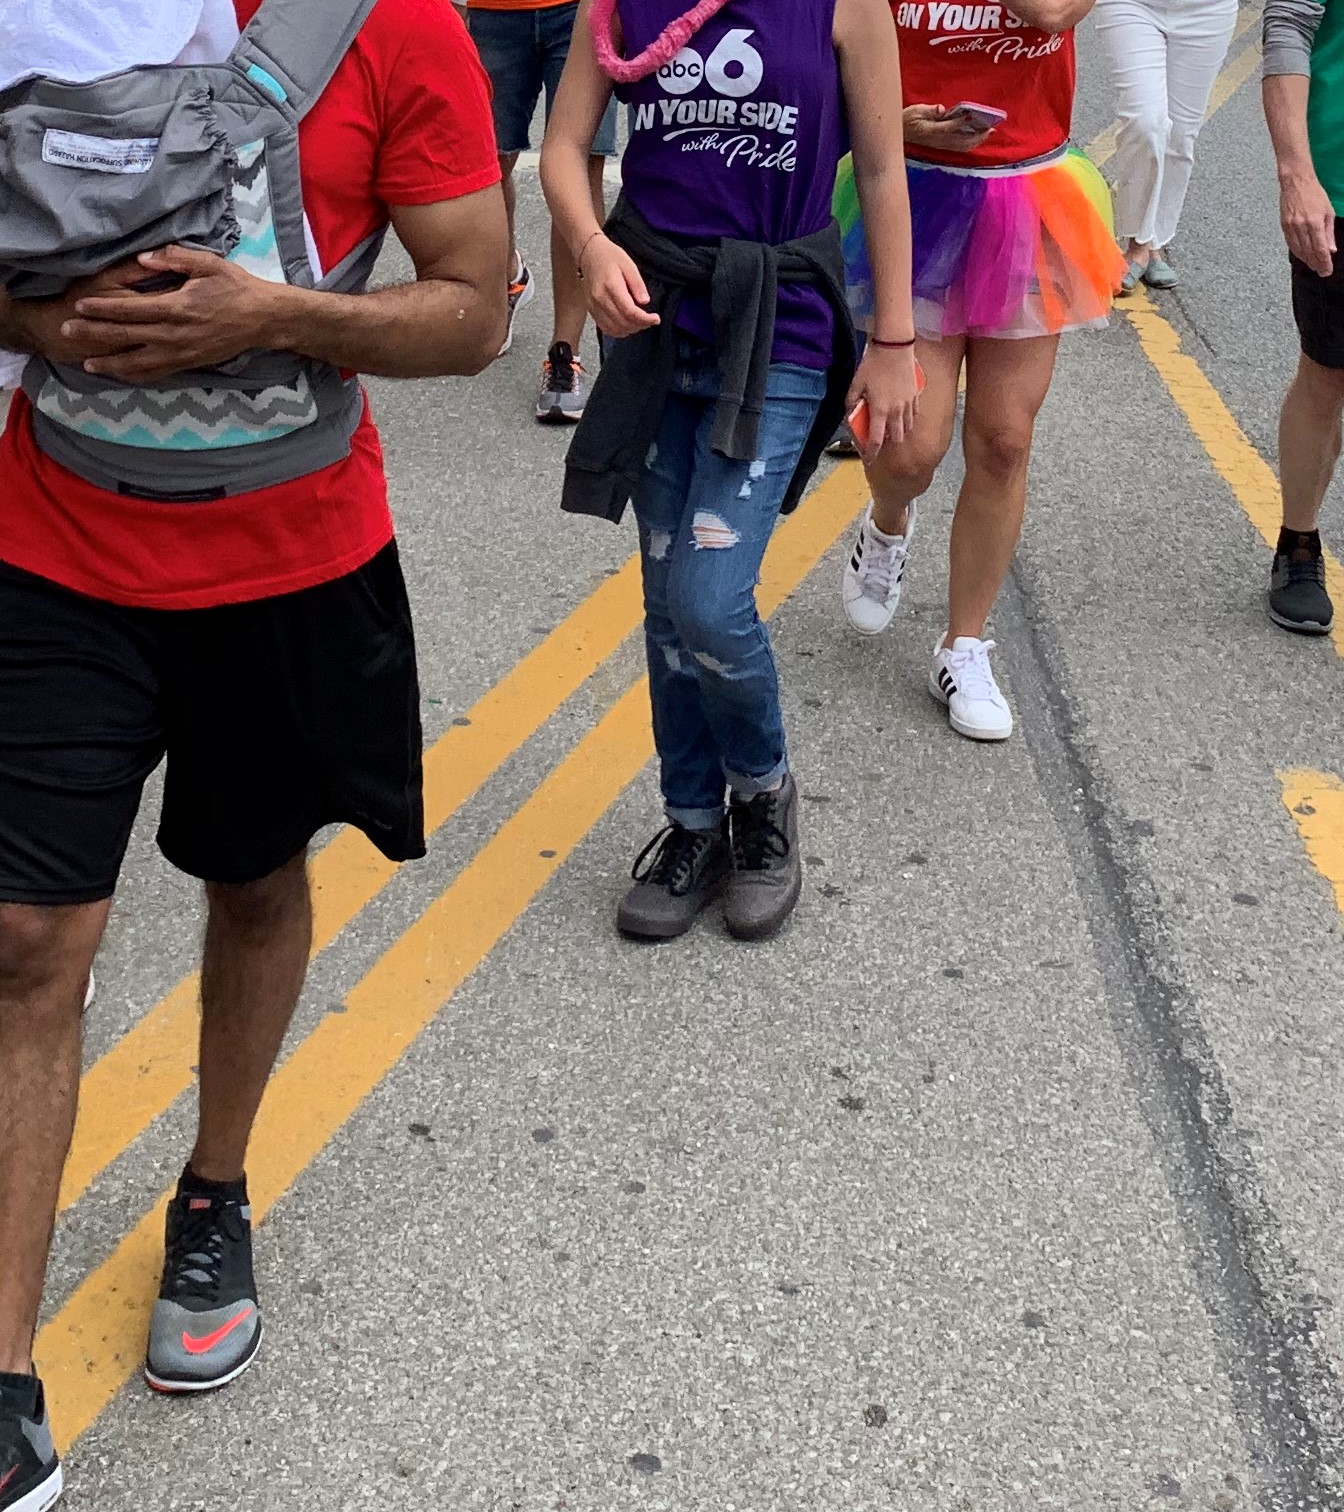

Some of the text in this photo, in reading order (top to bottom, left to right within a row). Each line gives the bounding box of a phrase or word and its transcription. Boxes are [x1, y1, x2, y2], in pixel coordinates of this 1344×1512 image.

[896, 1, 925, 30] ON
[927, 1, 1003, 32] YOUR
[705, 28, 764, 98] 6
[947, 33, 1065, 64] with Pride
[634, 98, 799, 136] N YOUR SIDE
[49, 148, 75, 161] HAZARD
[681, 132, 798, 173] with Pride
